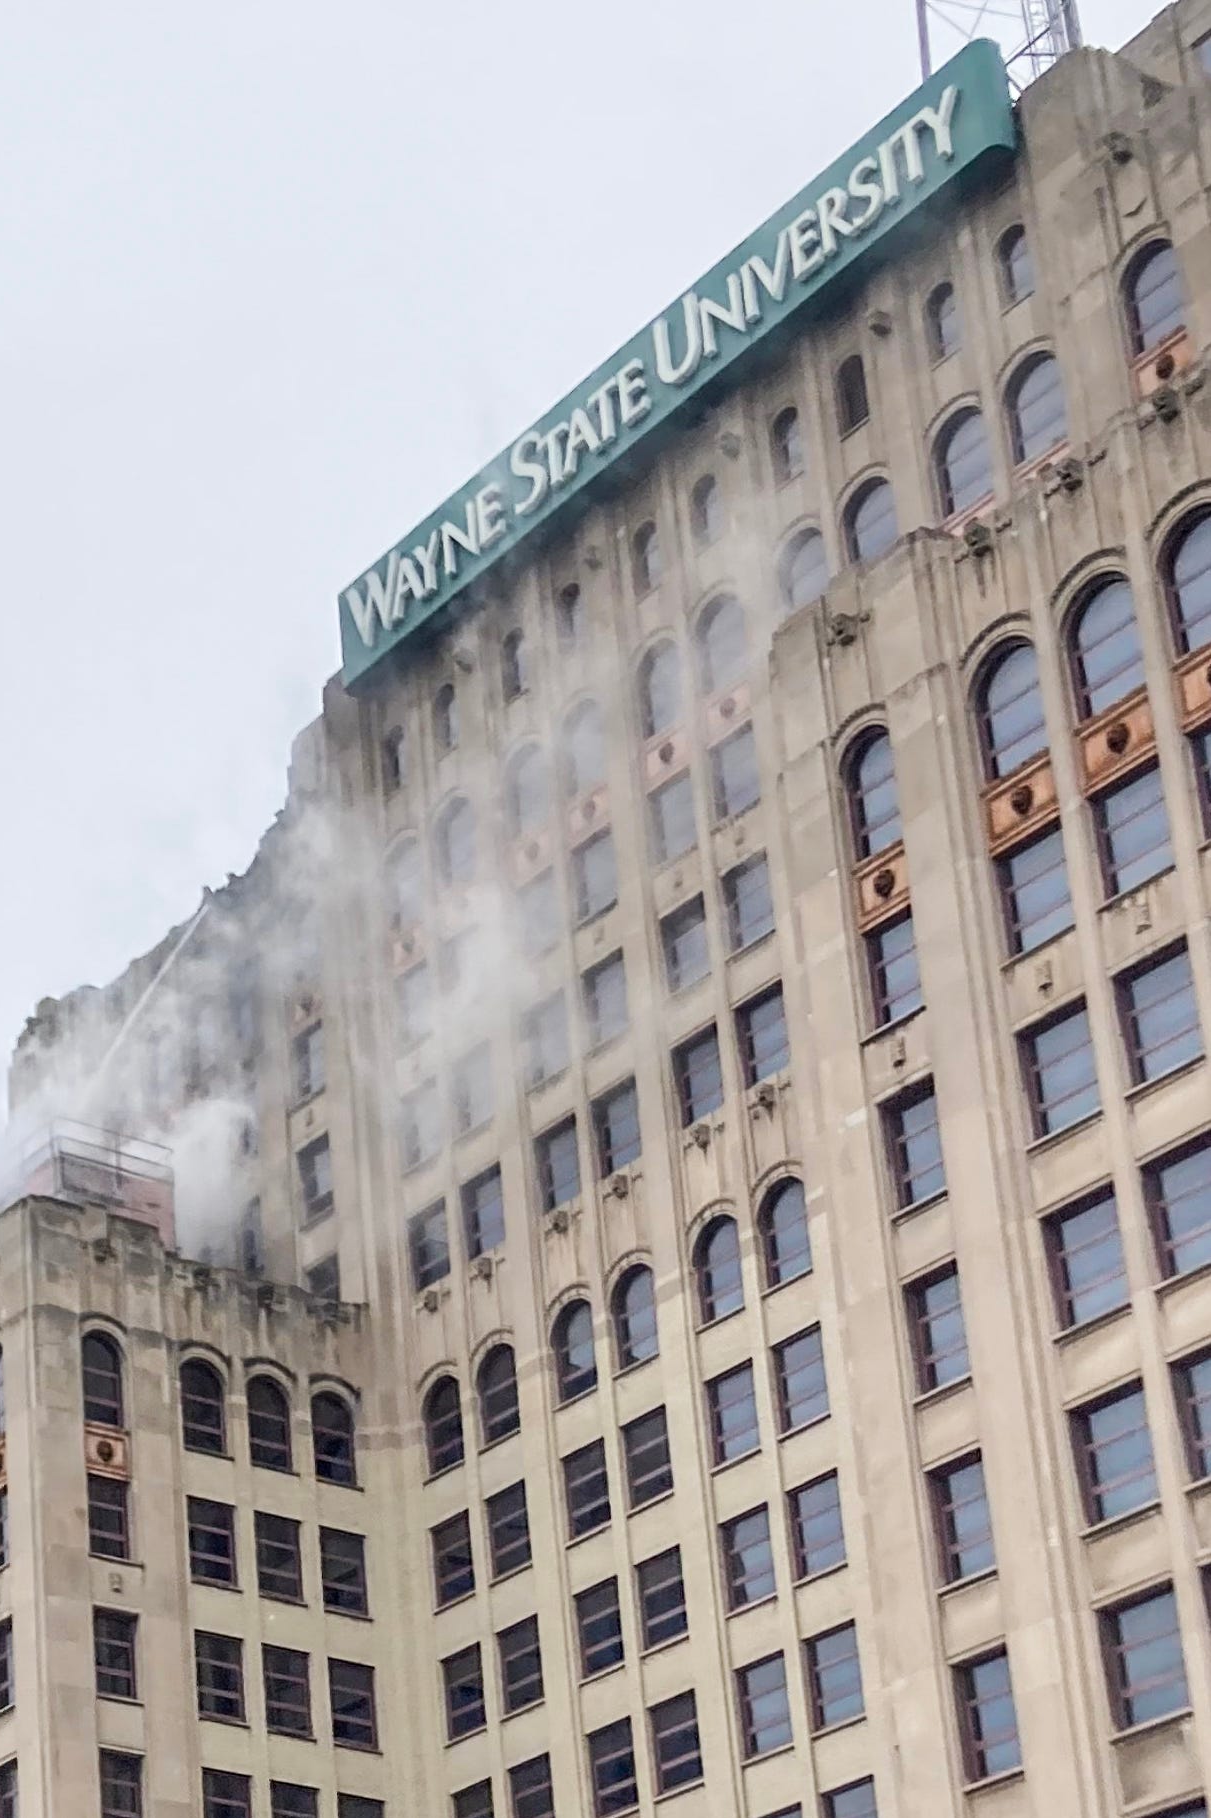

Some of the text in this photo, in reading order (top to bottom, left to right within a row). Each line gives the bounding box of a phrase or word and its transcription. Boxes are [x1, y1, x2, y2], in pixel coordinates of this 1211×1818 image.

[344, 86, 961, 648] WAYNE STATE UNIVERSITY
